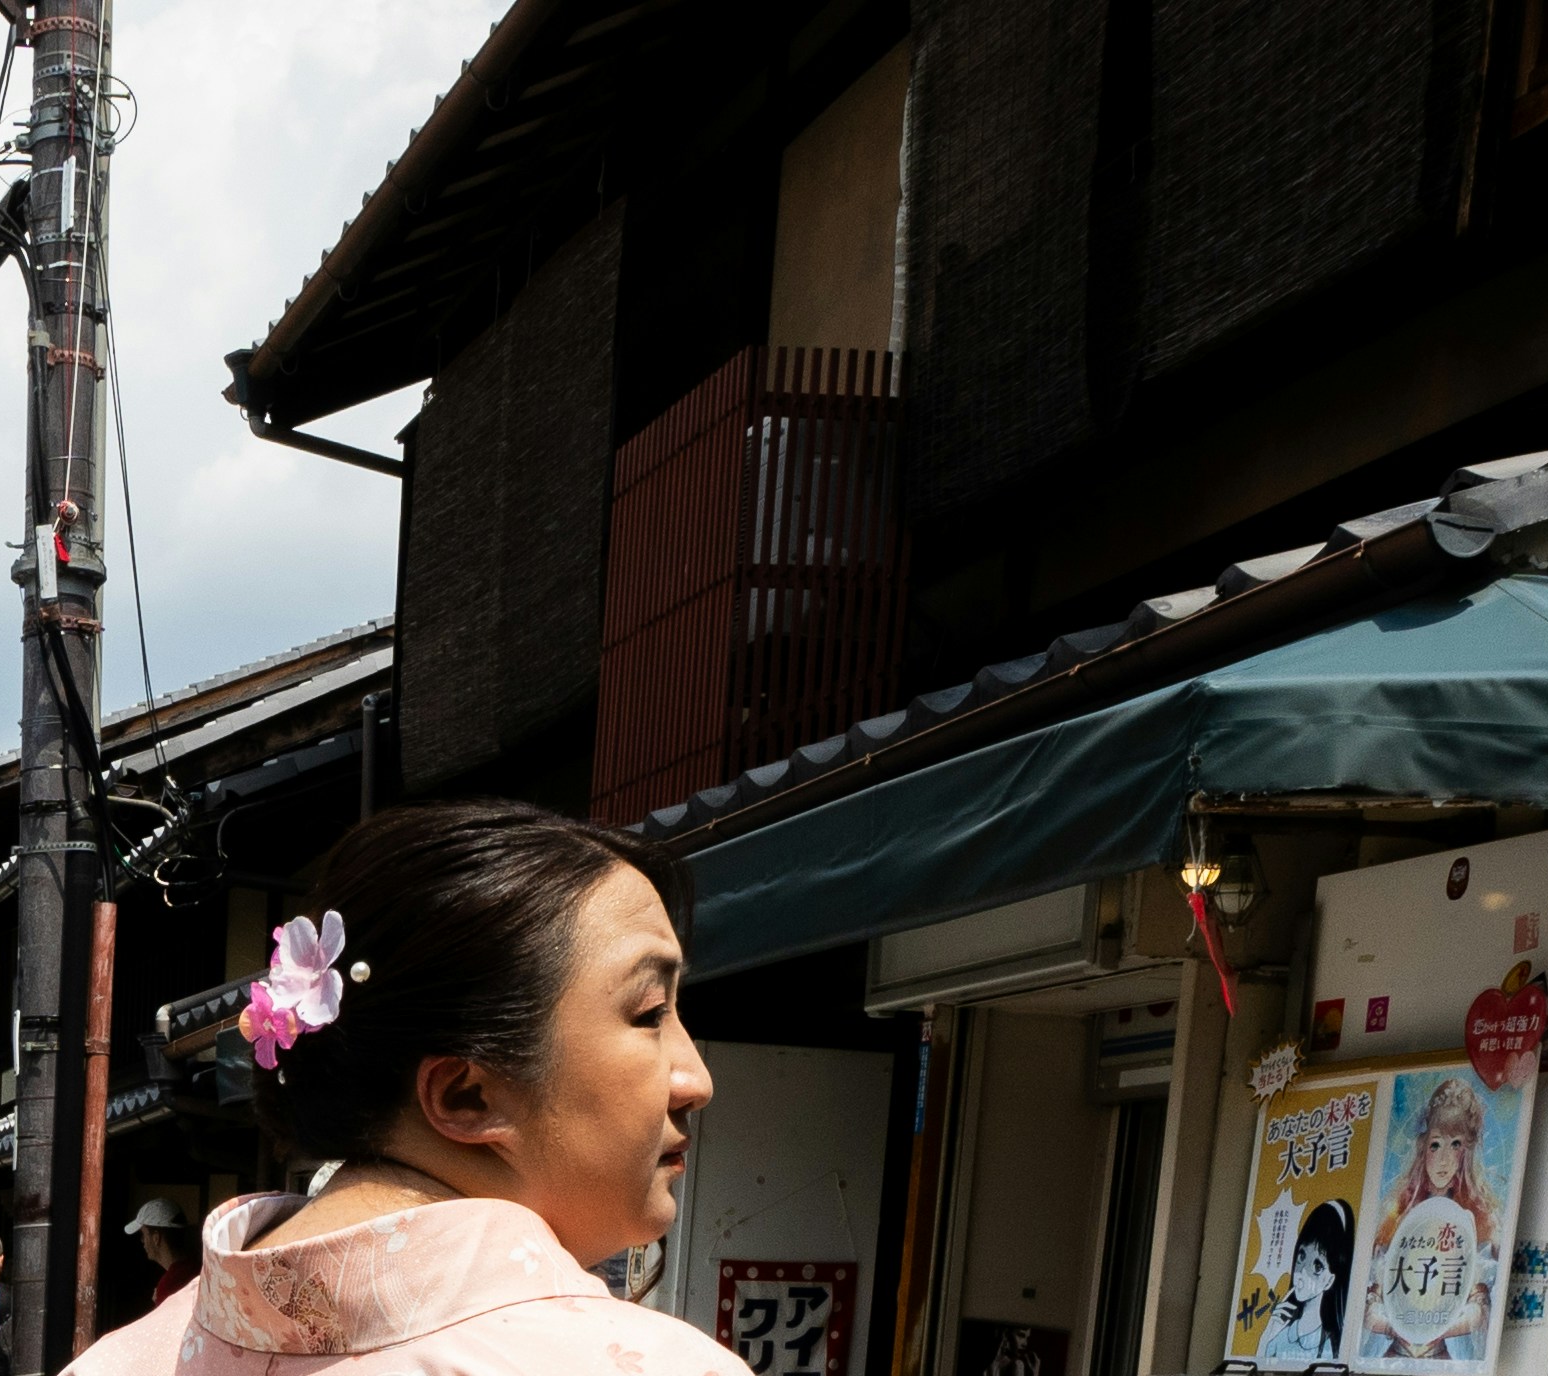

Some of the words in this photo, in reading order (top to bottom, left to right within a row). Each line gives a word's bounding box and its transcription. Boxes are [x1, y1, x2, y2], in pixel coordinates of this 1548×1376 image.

[1267, 1092, 1372, 1143] あなたの未来を
[1277, 1125, 1353, 1184] 大予言
[1400, 1222, 1465, 1253] あなたの恋を
[1387, 1254, 1467, 1297] 大予言
